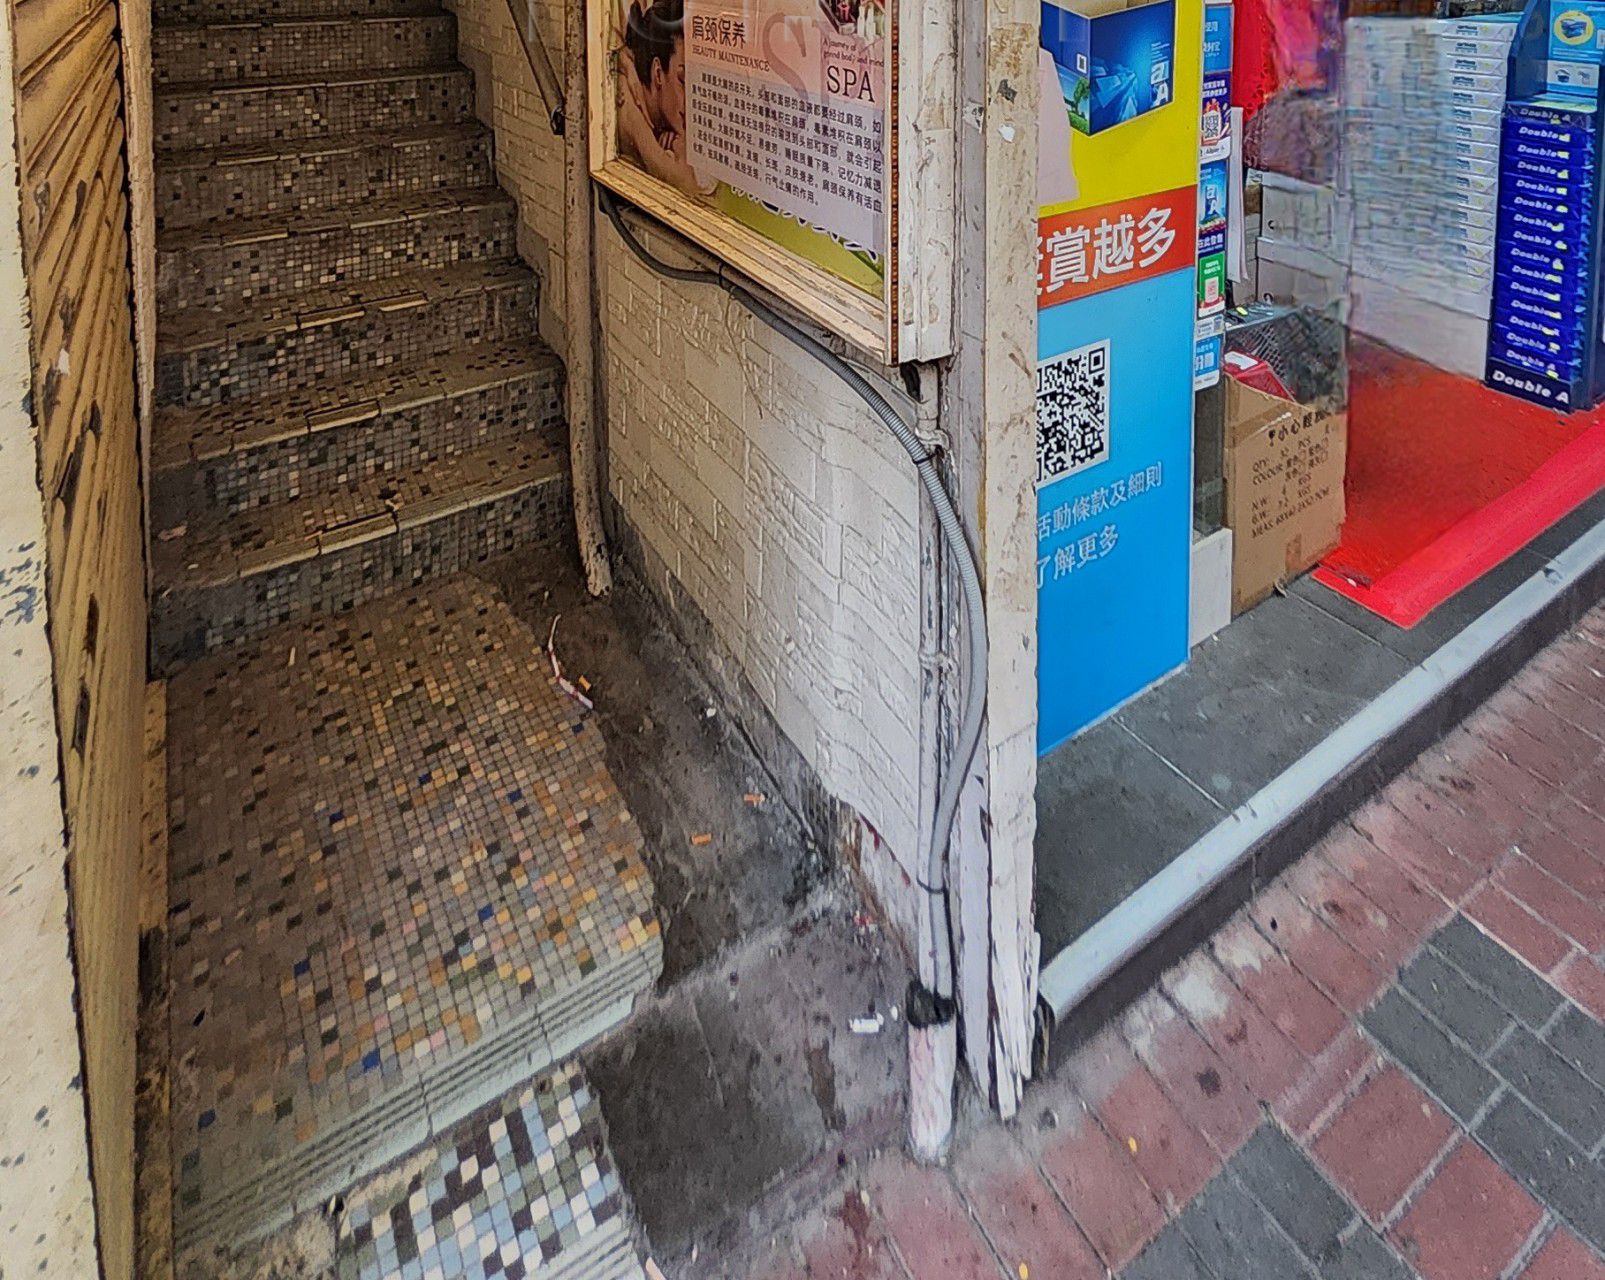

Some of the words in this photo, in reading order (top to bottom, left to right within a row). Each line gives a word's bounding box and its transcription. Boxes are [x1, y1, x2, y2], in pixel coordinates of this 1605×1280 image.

[692, 15, 746, 50] 肩颈保养
[718, 51, 770, 72] MAINTENANCE
[826, 65, 876, 104] SPA
[1492, 370, 1551, 398] Double
